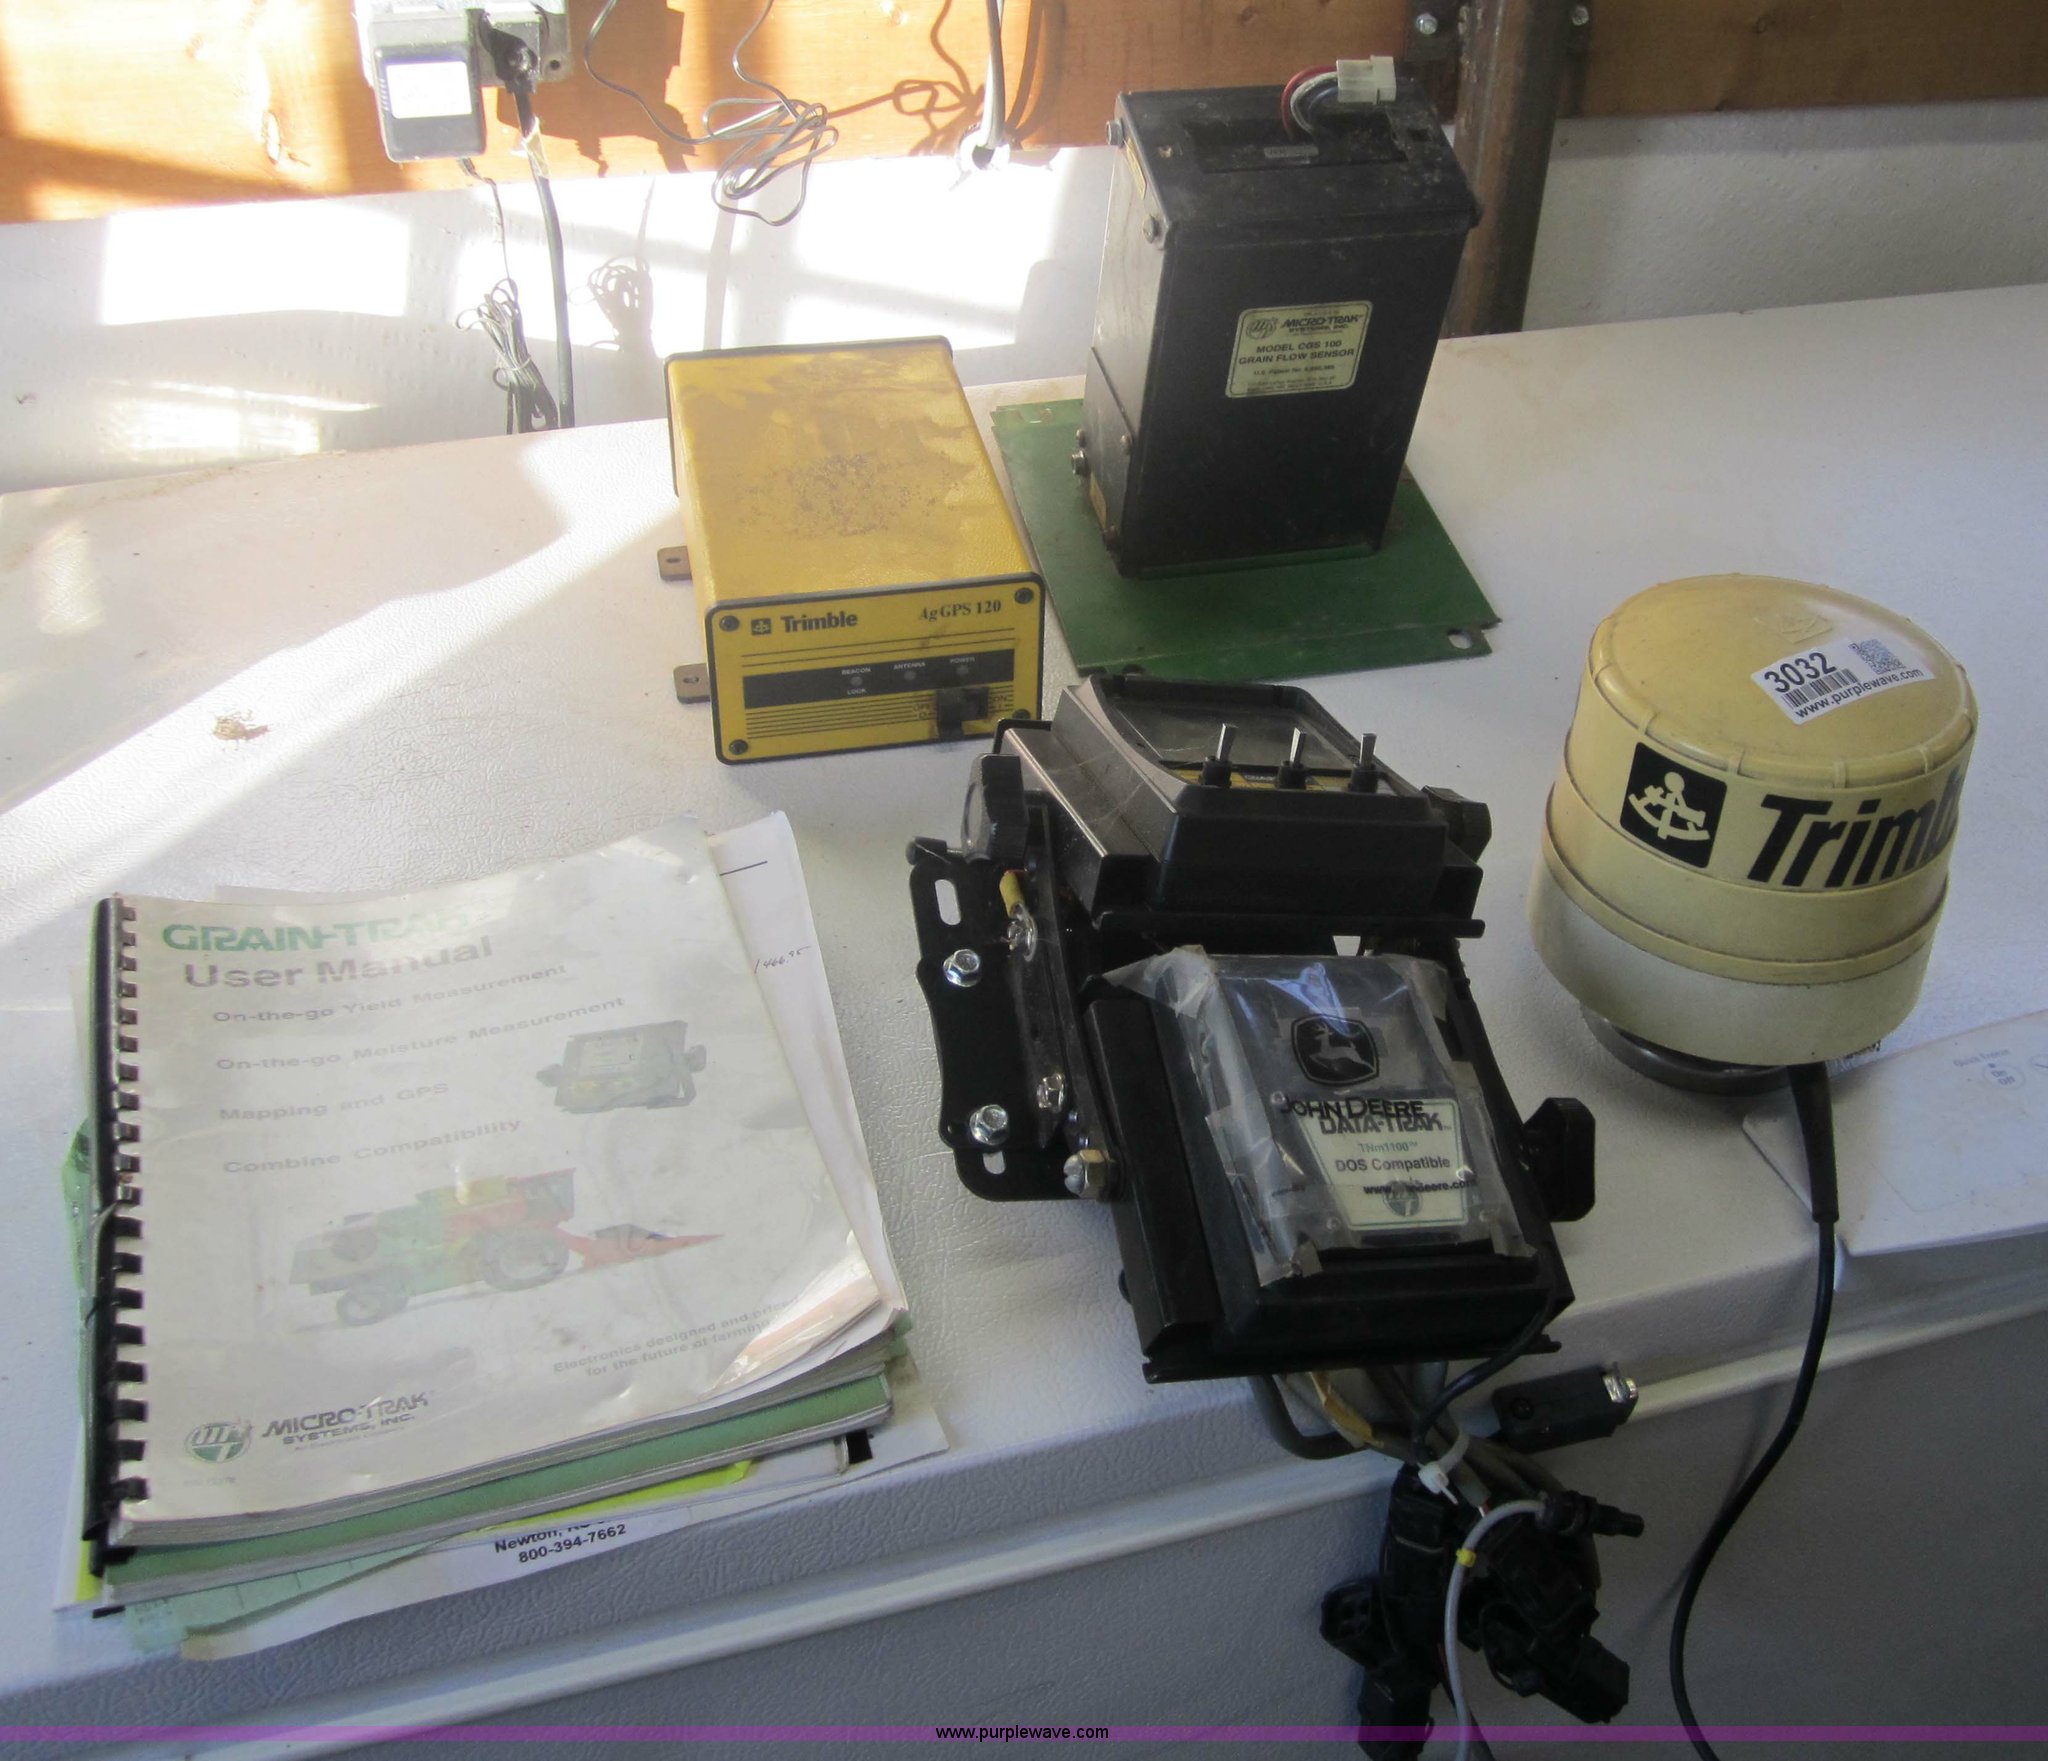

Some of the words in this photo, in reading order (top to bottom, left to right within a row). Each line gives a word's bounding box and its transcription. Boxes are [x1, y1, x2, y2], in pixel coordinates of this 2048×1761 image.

[1239, 354, 1273, 365] GRAIN
[1276, 352, 1307, 362] FLOW
[1310, 349, 1355, 359] SENSOR
[1256, 343, 1294, 353] MODEL
[1297, 341, 1321, 350] CGS
[1324, 339, 1342, 348] 100
[780, 611, 858, 633] Trimble
[918, 603, 972, 622] AgGPS
[976, 599, 1002, 614] 120
[841, 667, 871, 676] BEACON
[893, 661, 926, 670] ANTENNA
[950, 655, 976, 664] POWER
[1764, 651, 1837, 693] 3032
[1796, 667, 1924, 719] www.purplewave.com
[1747, 768, 1963, 888] Trimb
[185, 963, 304, 988] User
[316, 935, 493, 984] Manual
[213, 1005, 334, 1022] On-the-go
[343, 997, 402, 1014] Yield
[412, 964, 567, 1003] Measurement
[216, 1052, 341, 1070] On-the-go
[352, 1033, 457, 1060] Moisture
[468, 997, 626, 1040] Measurement
[218, 1102, 328, 1121] Mapping
[340, 1094, 384, 1111] and
[396, 1082, 449, 1101] GPS
[1280, 1095, 1343, 1119] JOHN
[1345, 1096, 1425, 1118] DEERE
[224, 1153, 341, 1173] Combine
[353, 1118, 521, 1160] Compatibility
[1335, 1158, 1368, 1173] DOS
[1371, 1155, 1450, 1176] Compatible
[553, 1345, 642, 1374] Electronics
[646, 1321, 716, 1349] designed
[721, 1314, 748, 1329] and
[586, 1365, 607, 1377] for
[613, 1355, 638, 1370] the
[641, 1343, 688, 1363] future
[692, 1338, 708, 1349] of
[262, 1392, 429, 1438] MICRO-TRAK
[282, 1421, 375, 1446] SYSTEMS,
[381, 1413, 415, 1425] INC.
[494, 1529, 563, 1553] Newton,
[518, 1523, 627, 1563] 800-394-7662
